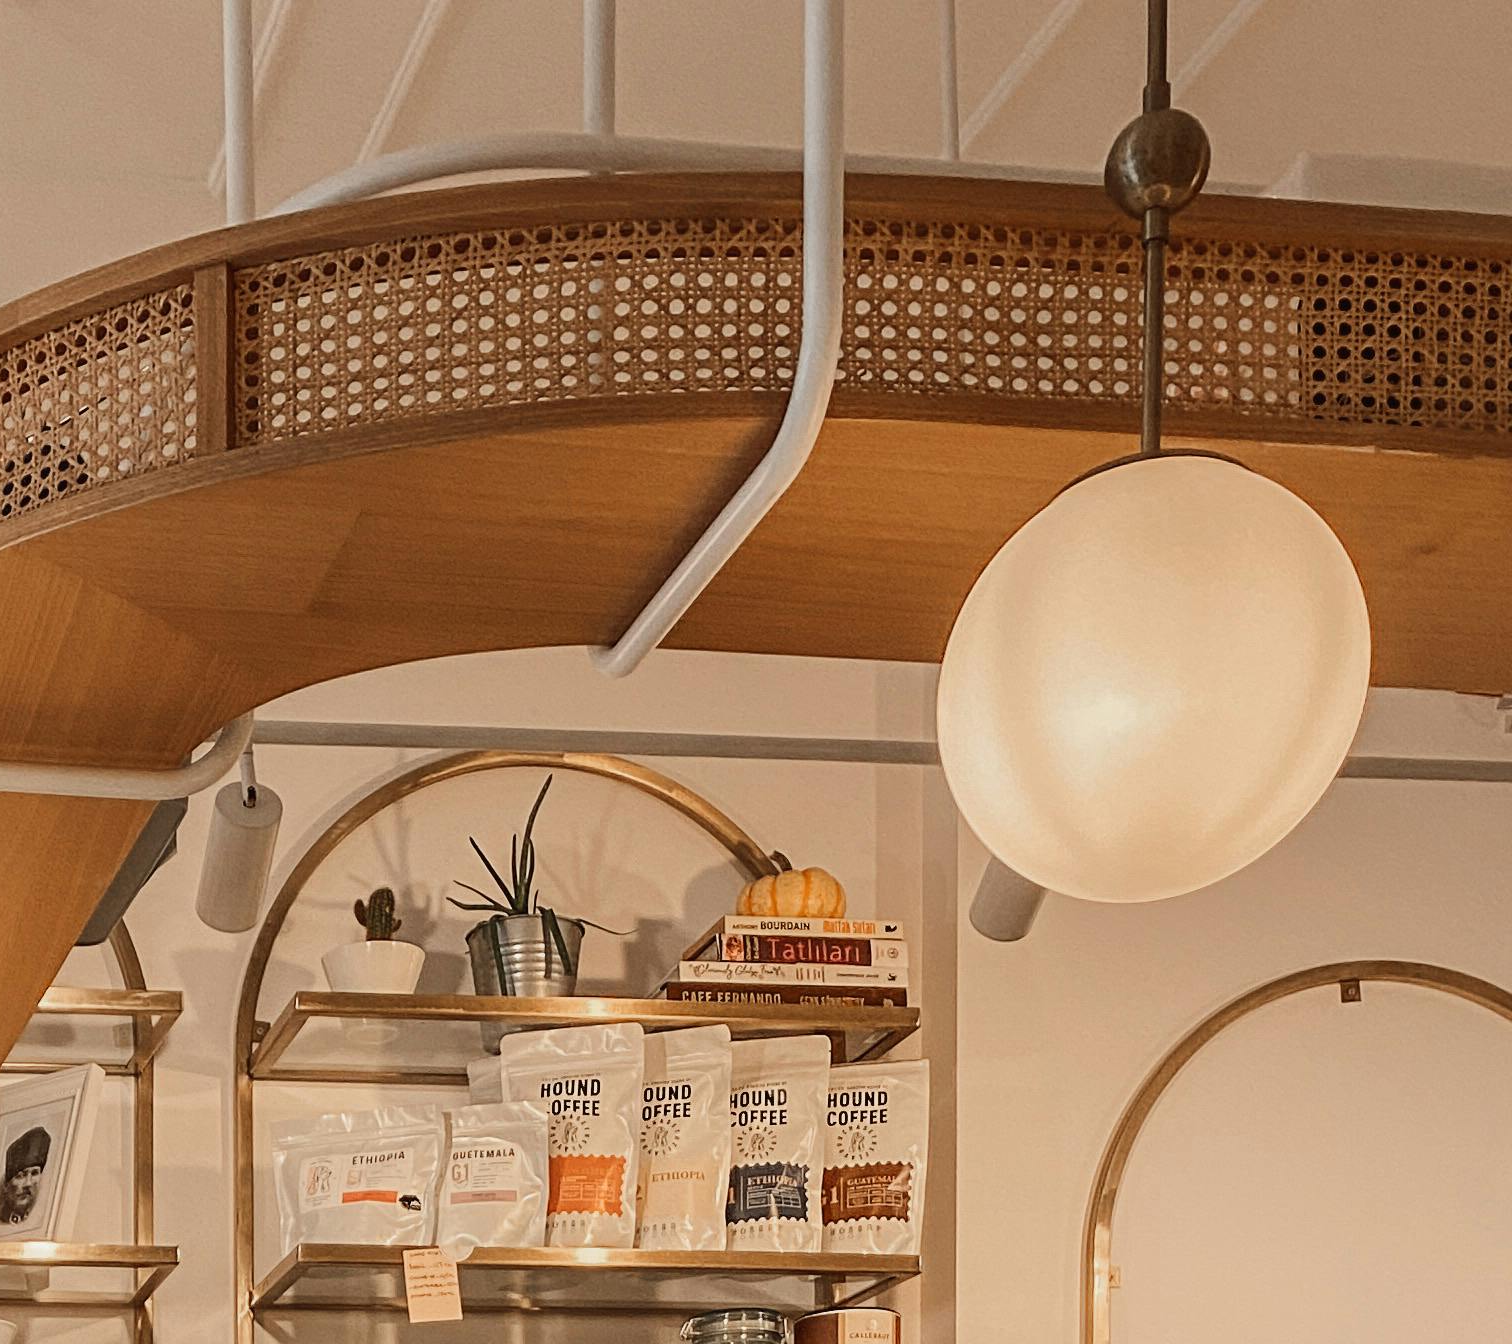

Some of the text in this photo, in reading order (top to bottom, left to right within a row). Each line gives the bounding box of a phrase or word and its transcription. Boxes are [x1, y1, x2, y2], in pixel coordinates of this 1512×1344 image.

[760, 920, 810, 932] BOURDAIN
[767, 938, 860, 962] Tatlıları
[682, 990, 712, 1002] CAFE
[540, 1079, 601, 1098] HOUND
[643, 1084, 692, 1103] OUND
[729, 1088, 788, 1109] HOUND
[826, 1091, 888, 1109] HOUND
[547, 1099, 600, 1117] OFFEE
[641, 1102, 691, 1121] OFFEE
[826, 1109, 888, 1127] COFFEE
[352, 1151, 405, 1166] ETHIOPIA
[652, 1171, 706, 1183] ETHIOPIA
